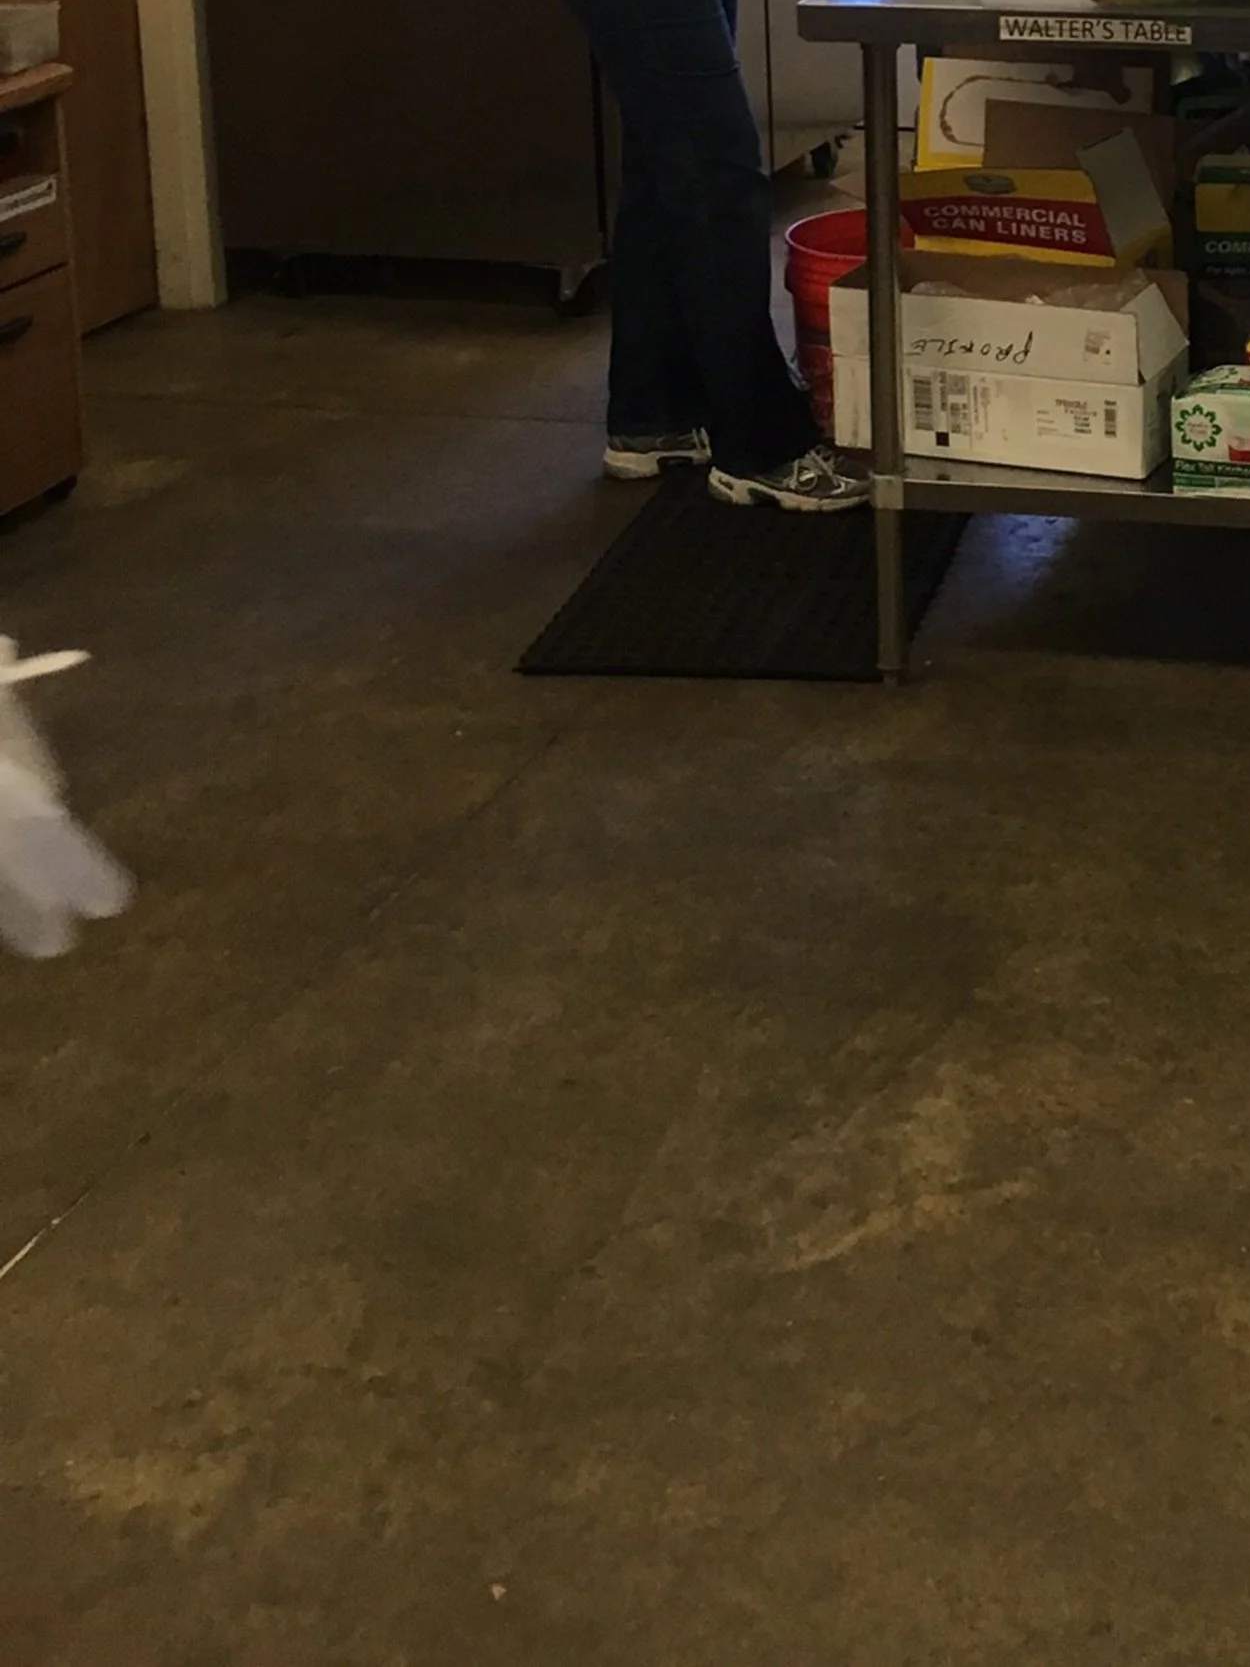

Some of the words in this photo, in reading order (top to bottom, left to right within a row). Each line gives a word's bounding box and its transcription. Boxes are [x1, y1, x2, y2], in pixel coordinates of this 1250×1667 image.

[1005, 19, 1114, 40] WALTER'S
[1120, 22, 1188, 42] TABLE
[924, 204, 1087, 228] COMMERCIAL
[932, 217, 986, 232] CAN
[997, 221, 1087, 244] LINERS
